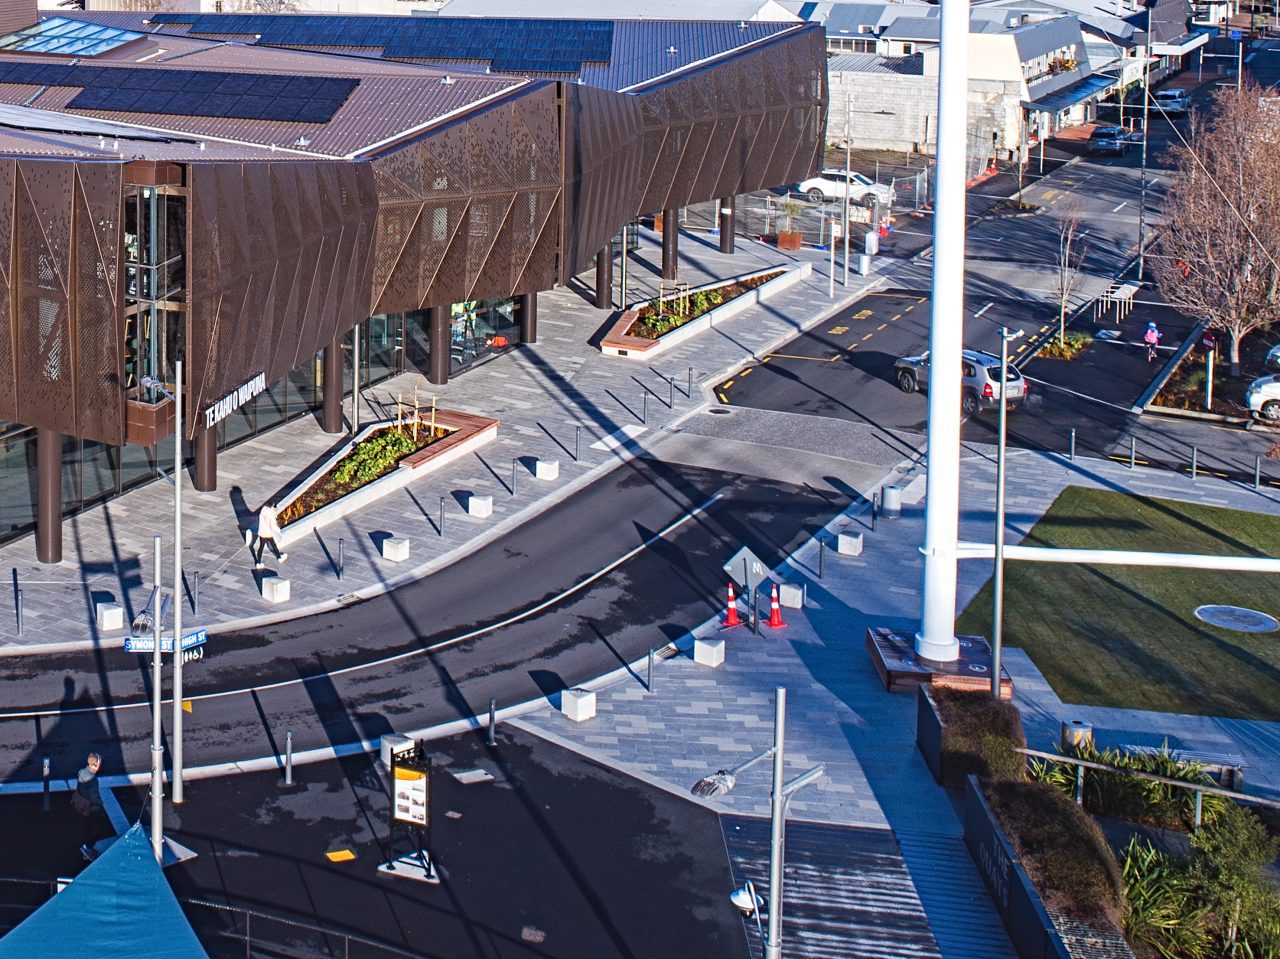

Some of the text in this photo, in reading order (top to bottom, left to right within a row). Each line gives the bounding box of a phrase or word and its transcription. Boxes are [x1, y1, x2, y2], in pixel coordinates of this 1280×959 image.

[205, 372, 266, 429] TE KAHU O WAIPUNA
[125, 640, 173, 651] SYMON ST
[182, 631, 206, 647] HIGH ST
